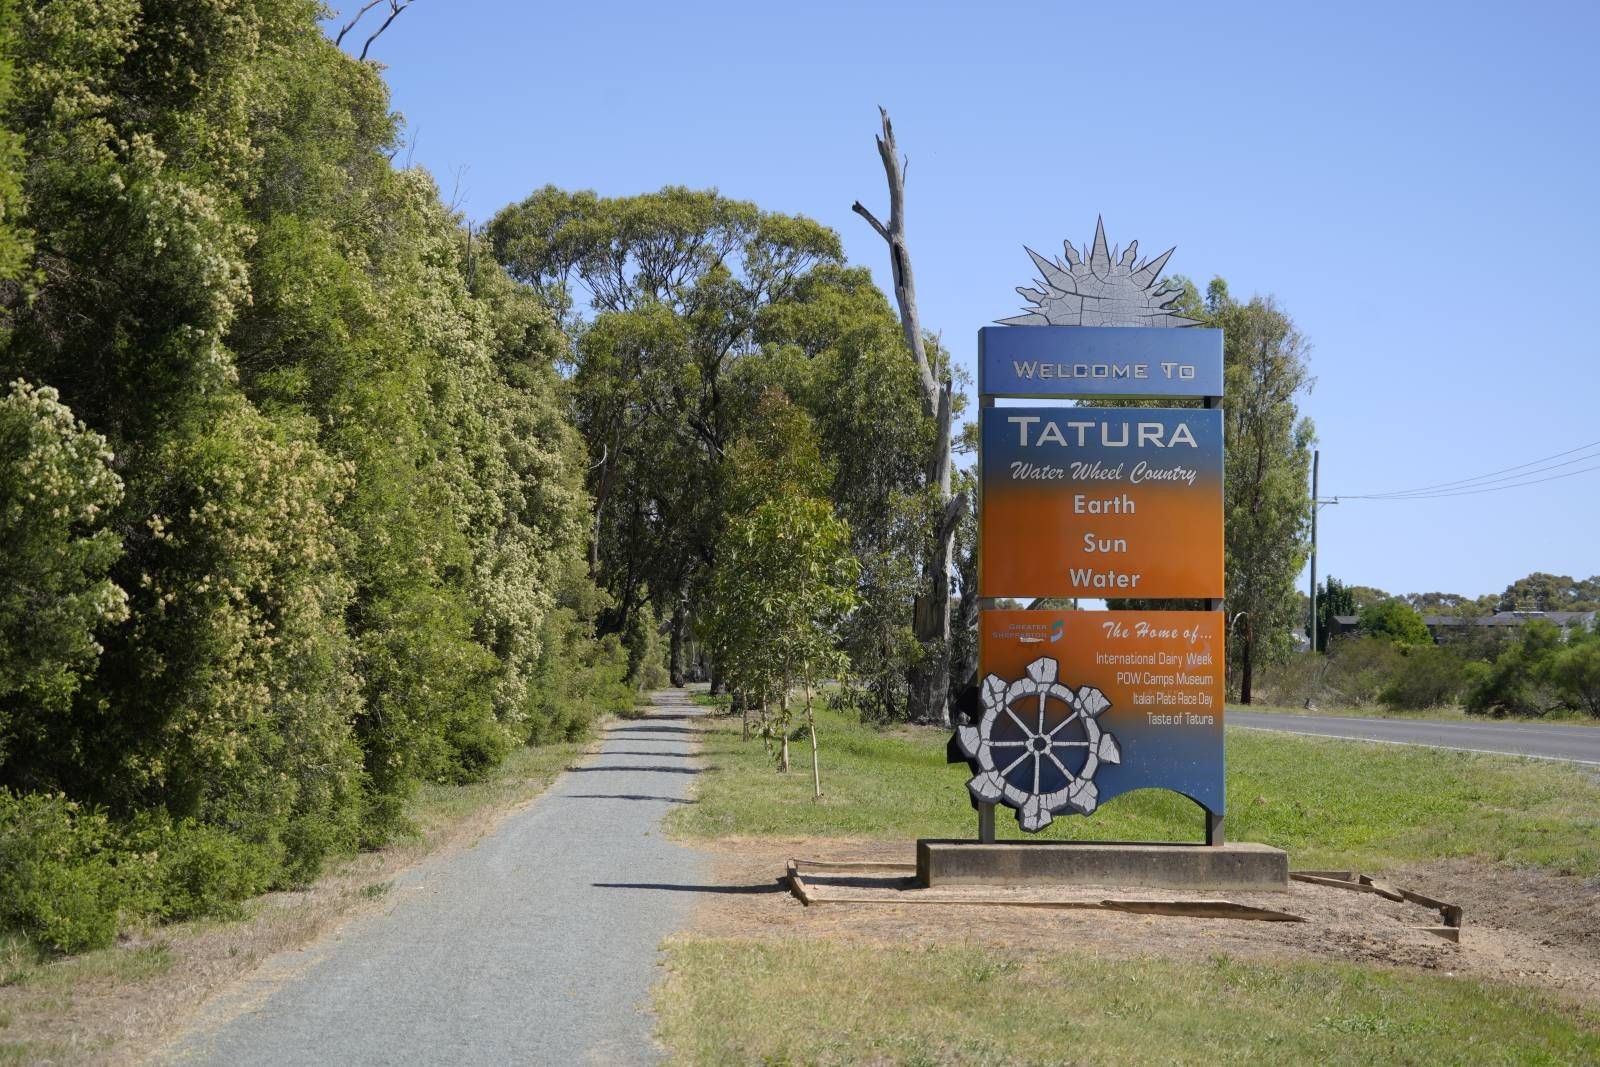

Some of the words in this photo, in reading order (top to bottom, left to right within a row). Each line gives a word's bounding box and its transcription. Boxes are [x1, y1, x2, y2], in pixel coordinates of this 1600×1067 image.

[1010, 460, 1065, 481] Water
[1070, 460, 1123, 481] Wheel
[1129, 460, 1197, 486] Country
[1073, 493, 1136, 514] Earth
[1083, 533, 1128, 553] Sun
[1069, 568, 1141, 588] Water
[1102, 621, 1129, 640] The
[1135, 621, 1178, 640] Home
[1096, 652, 1156, 666] International
[1158, 652, 1183, 668] Dairy
[1186, 652, 1213, 666] Week
[1116, 672, 1141, 686] POW
[1143, 672, 1174, 687] Camps
[1176, 672, 1214, 686] Museum
[1133, 692, 1155, 705] Italian
[1156, 692, 1177, 705] Plate
[1178, 692, 1197, 705] Race
[1198, 692, 1213, 708] Day
[1147, 712, 1172, 725] Taste
[1173, 712, 1184, 725] of
[1184, 712, 1214, 725] Tatura
